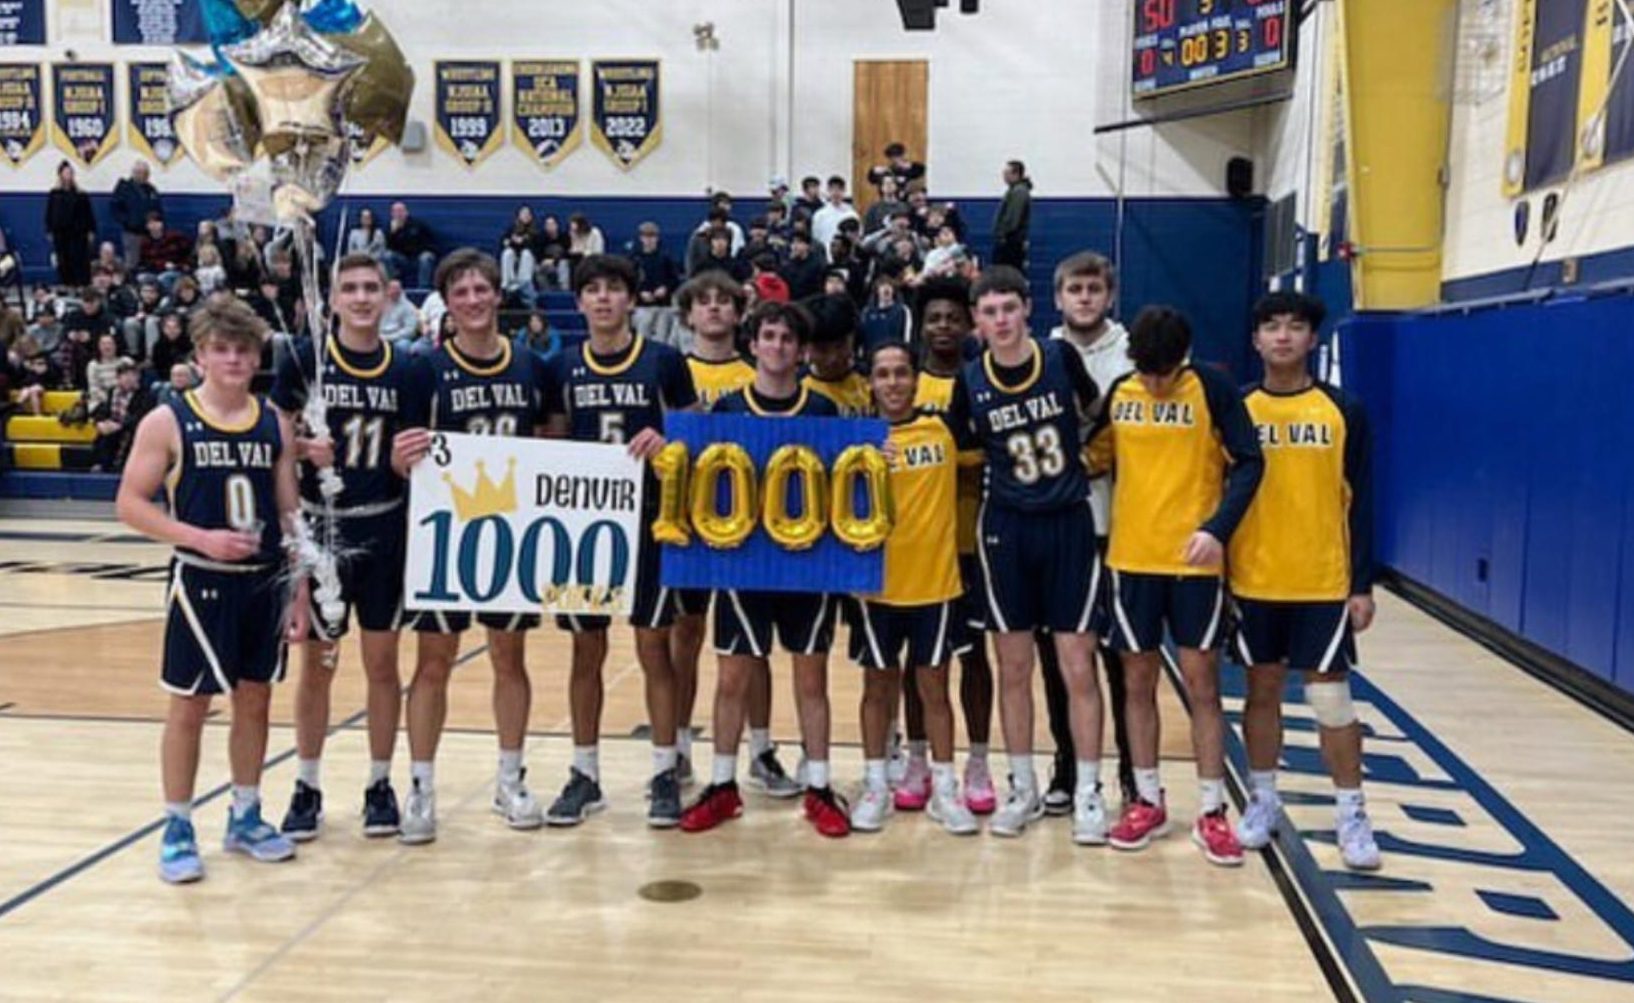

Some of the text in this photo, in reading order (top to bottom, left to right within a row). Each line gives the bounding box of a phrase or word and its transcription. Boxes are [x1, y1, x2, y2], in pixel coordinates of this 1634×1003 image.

[451, 116, 487, 137] 1999
[528, 117, 565, 137] 2013
[606, 116, 646, 137] 2022
[451, 384, 528, 412] DEL VAL
[574, 384, 649, 408] DEL VAL
[988, 391, 1063, 432] DEL VAL
[1152, 402, 1194, 426] VAL
[343, 415, 384, 468] 11
[1288, 423, 1332, 446] VAL
[193, 442, 235, 467] DEL
[1007, 424, 1064, 484] 33
[226, 473, 256, 528] 0
[652, 440, 897, 551] 1000
[414, 508, 630, 605] 1000
